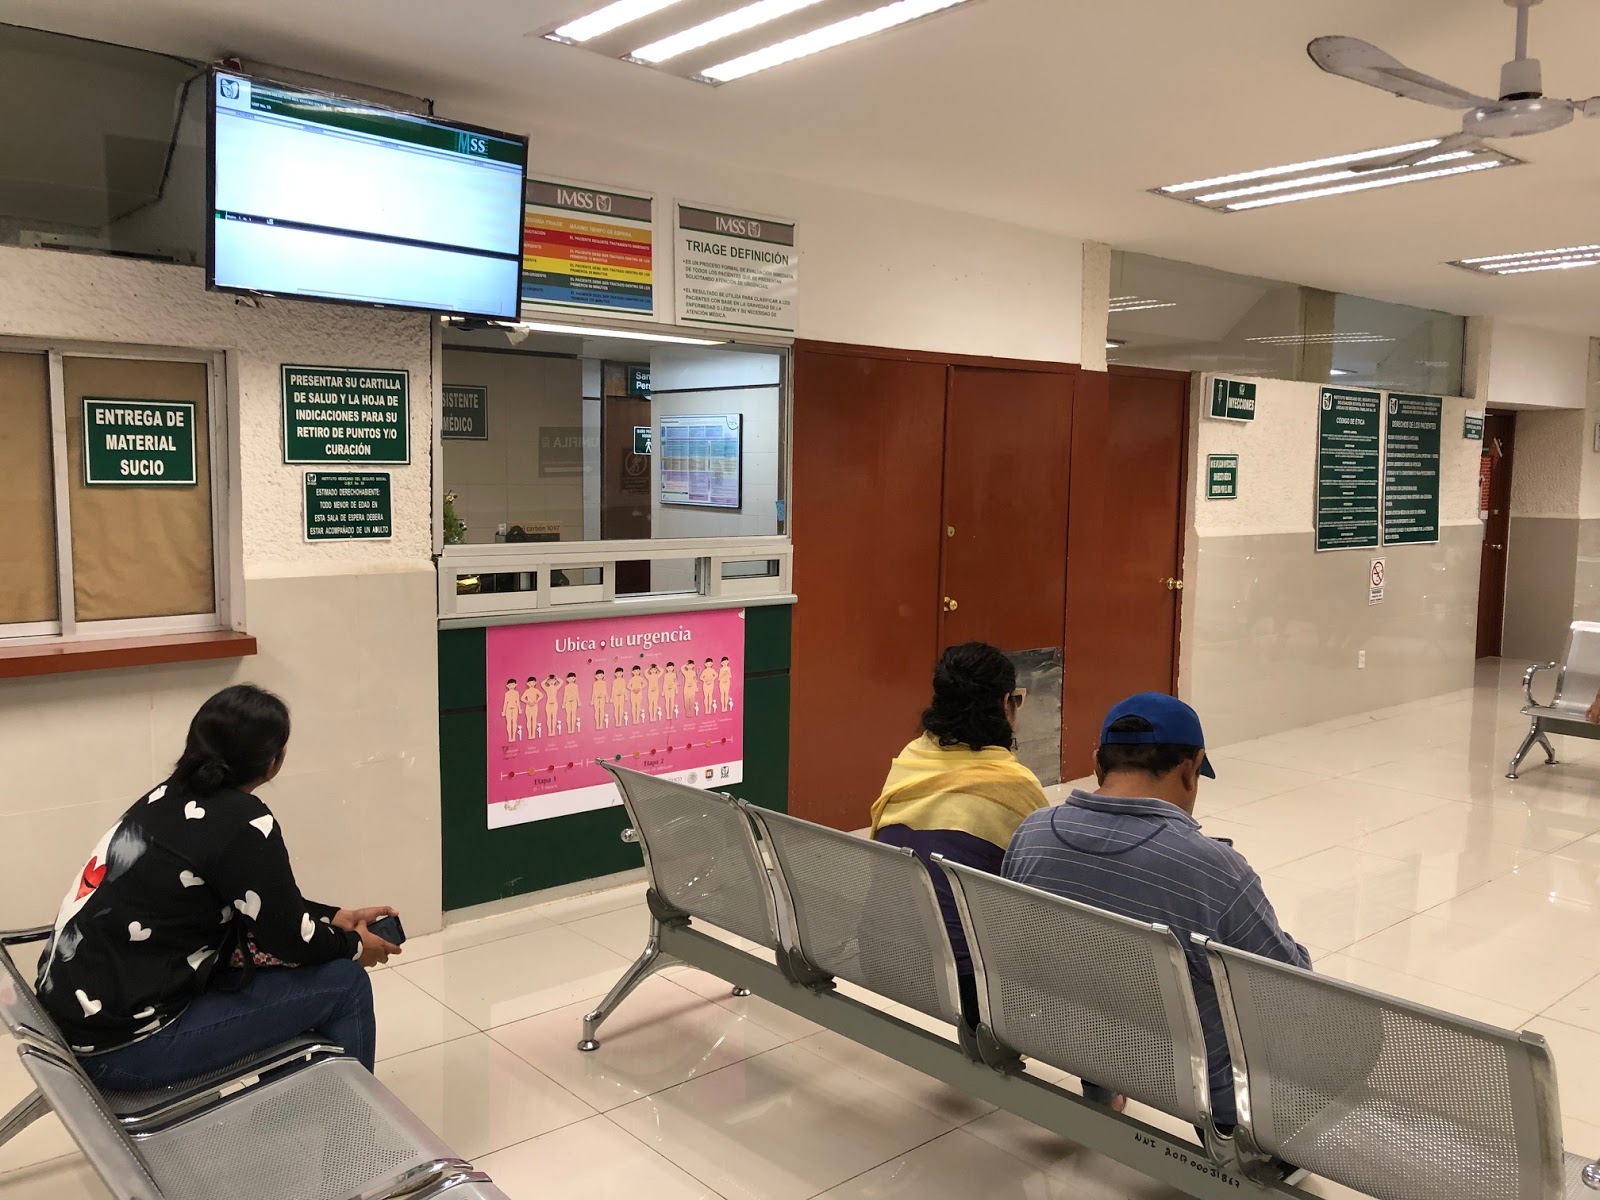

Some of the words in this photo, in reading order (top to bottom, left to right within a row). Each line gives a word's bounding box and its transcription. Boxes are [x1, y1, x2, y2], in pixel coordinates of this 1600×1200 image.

[558, 189, 593, 208] IMSS
[716, 216, 745, 234] IMSS
[686, 240, 727, 256] TRIAGE
[731, 247, 788, 266] DEFINICIÓN
[686, 274, 714, 282] SOLICITANDO
[692, 288, 718, 296] RESULTADO
[686, 302, 715, 310] ENFERMEDAD
[290, 374, 343, 387] PRESENTAR
[345, 377, 357, 388] SU
[360, 378, 401, 390] CARTILLA
[636, 372, 650, 380] San
[294, 392, 306, 403] DE
[308, 393, 337, 403] SALUD
[340, 394, 346, 404] Y
[348, 394, 360, 404] LA
[362, 395, 385, 406] HOJA
[387, 396, 398, 406] DE
[442, 392, 478, 408] SISTENTE
[1228, 397, 1254, 410] INYECCIONES
[95, 408, 163, 426] ENTREGA
[166, 411, 184, 426] DE
[296, 409, 359, 421] INDICACIONES
[362, 411, 384, 422] PARA
[386, 412, 397, 422] SU
[443, 413, 472, 432] MÉDICO
[1355, 417, 1365, 425] ÉTICA
[297, 426, 329, 437] RETIRO
[332, 427, 344, 438] DE
[346, 427, 380, 439] PUNTOS
[383, 428, 397, 439] Y/O
[106, 434, 176, 451] MATERIAL
[325, 442, 371, 455] CURACIÓN
[120, 459, 164, 476] SUCIO
[325, 525, 354, 534] ACOMPAÑADO
[555, 637, 596, 653] Ubica
[610, 635, 623, 648] tu
[626, 625, 692, 650] urgencia
